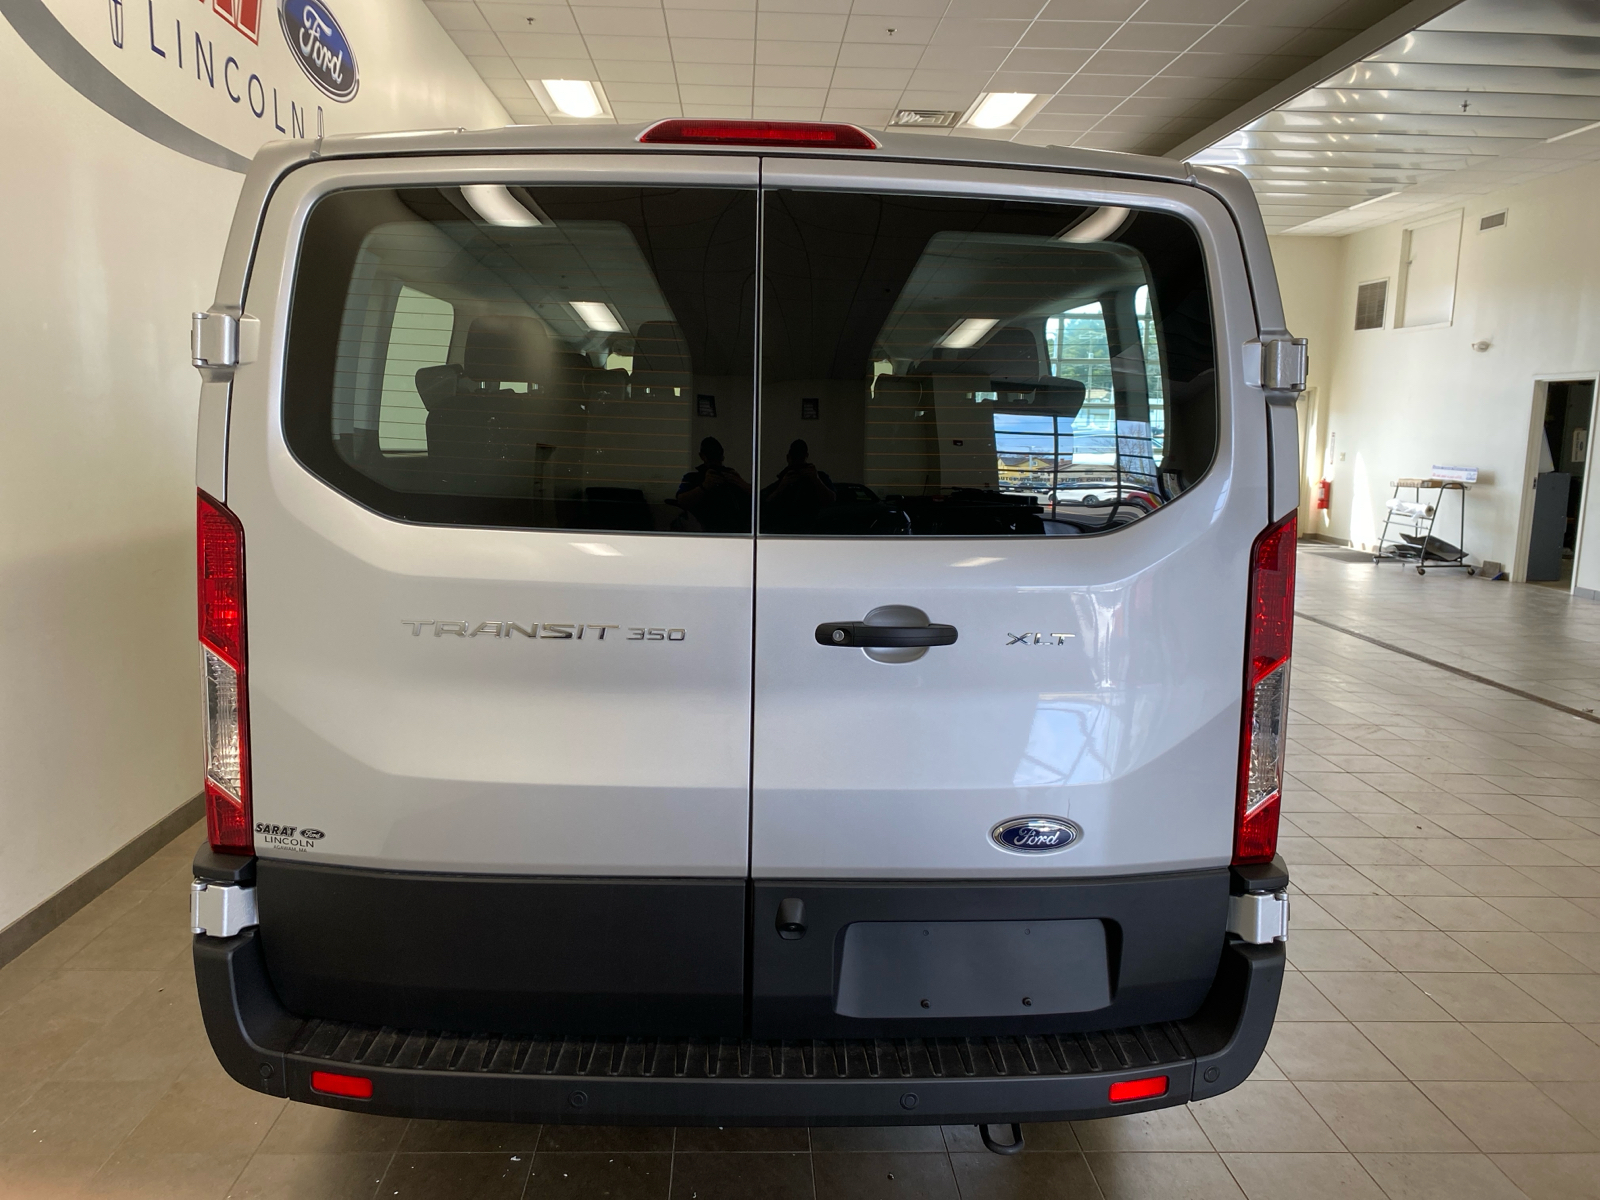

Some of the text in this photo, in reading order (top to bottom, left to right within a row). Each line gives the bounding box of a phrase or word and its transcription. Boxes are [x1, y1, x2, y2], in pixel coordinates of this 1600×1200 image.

[299, 4, 344, 85] Ford
[147, 0, 305, 139] LINCOLN
[401, 619, 688, 642] TRANSIT 350
[1005, 631, 1076, 646] XLT
[255, 822, 297, 837] SARAT
[1013, 826, 1060, 846] Ford
[264, 835, 314, 847] LINCOLN
